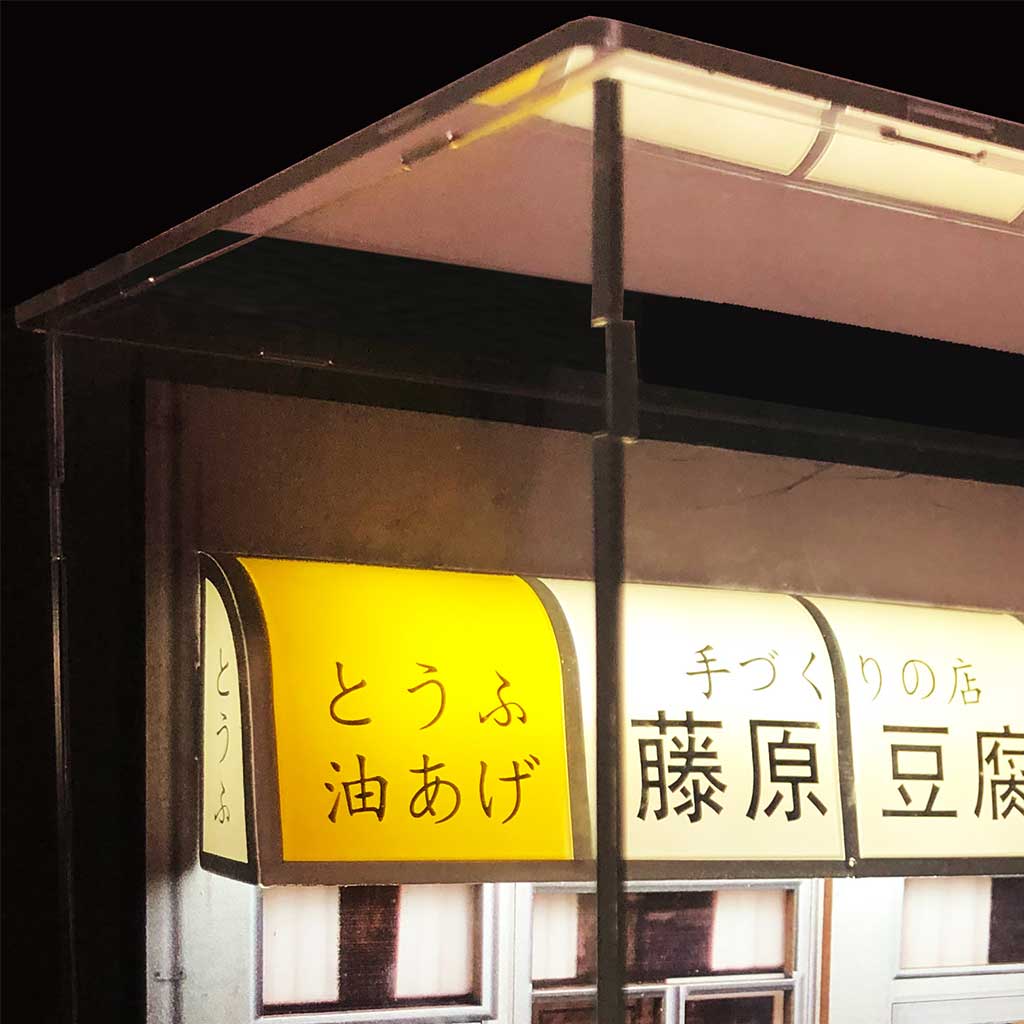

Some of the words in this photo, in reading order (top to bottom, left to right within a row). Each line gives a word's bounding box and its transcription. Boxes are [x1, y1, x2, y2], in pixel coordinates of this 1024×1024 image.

[328, 661, 528, 730] とうふ
[686, 645, 982, 706] 手づくりの店
[213, 648, 231, 825] とうふ
[327, 754, 541, 825] 油あげ
